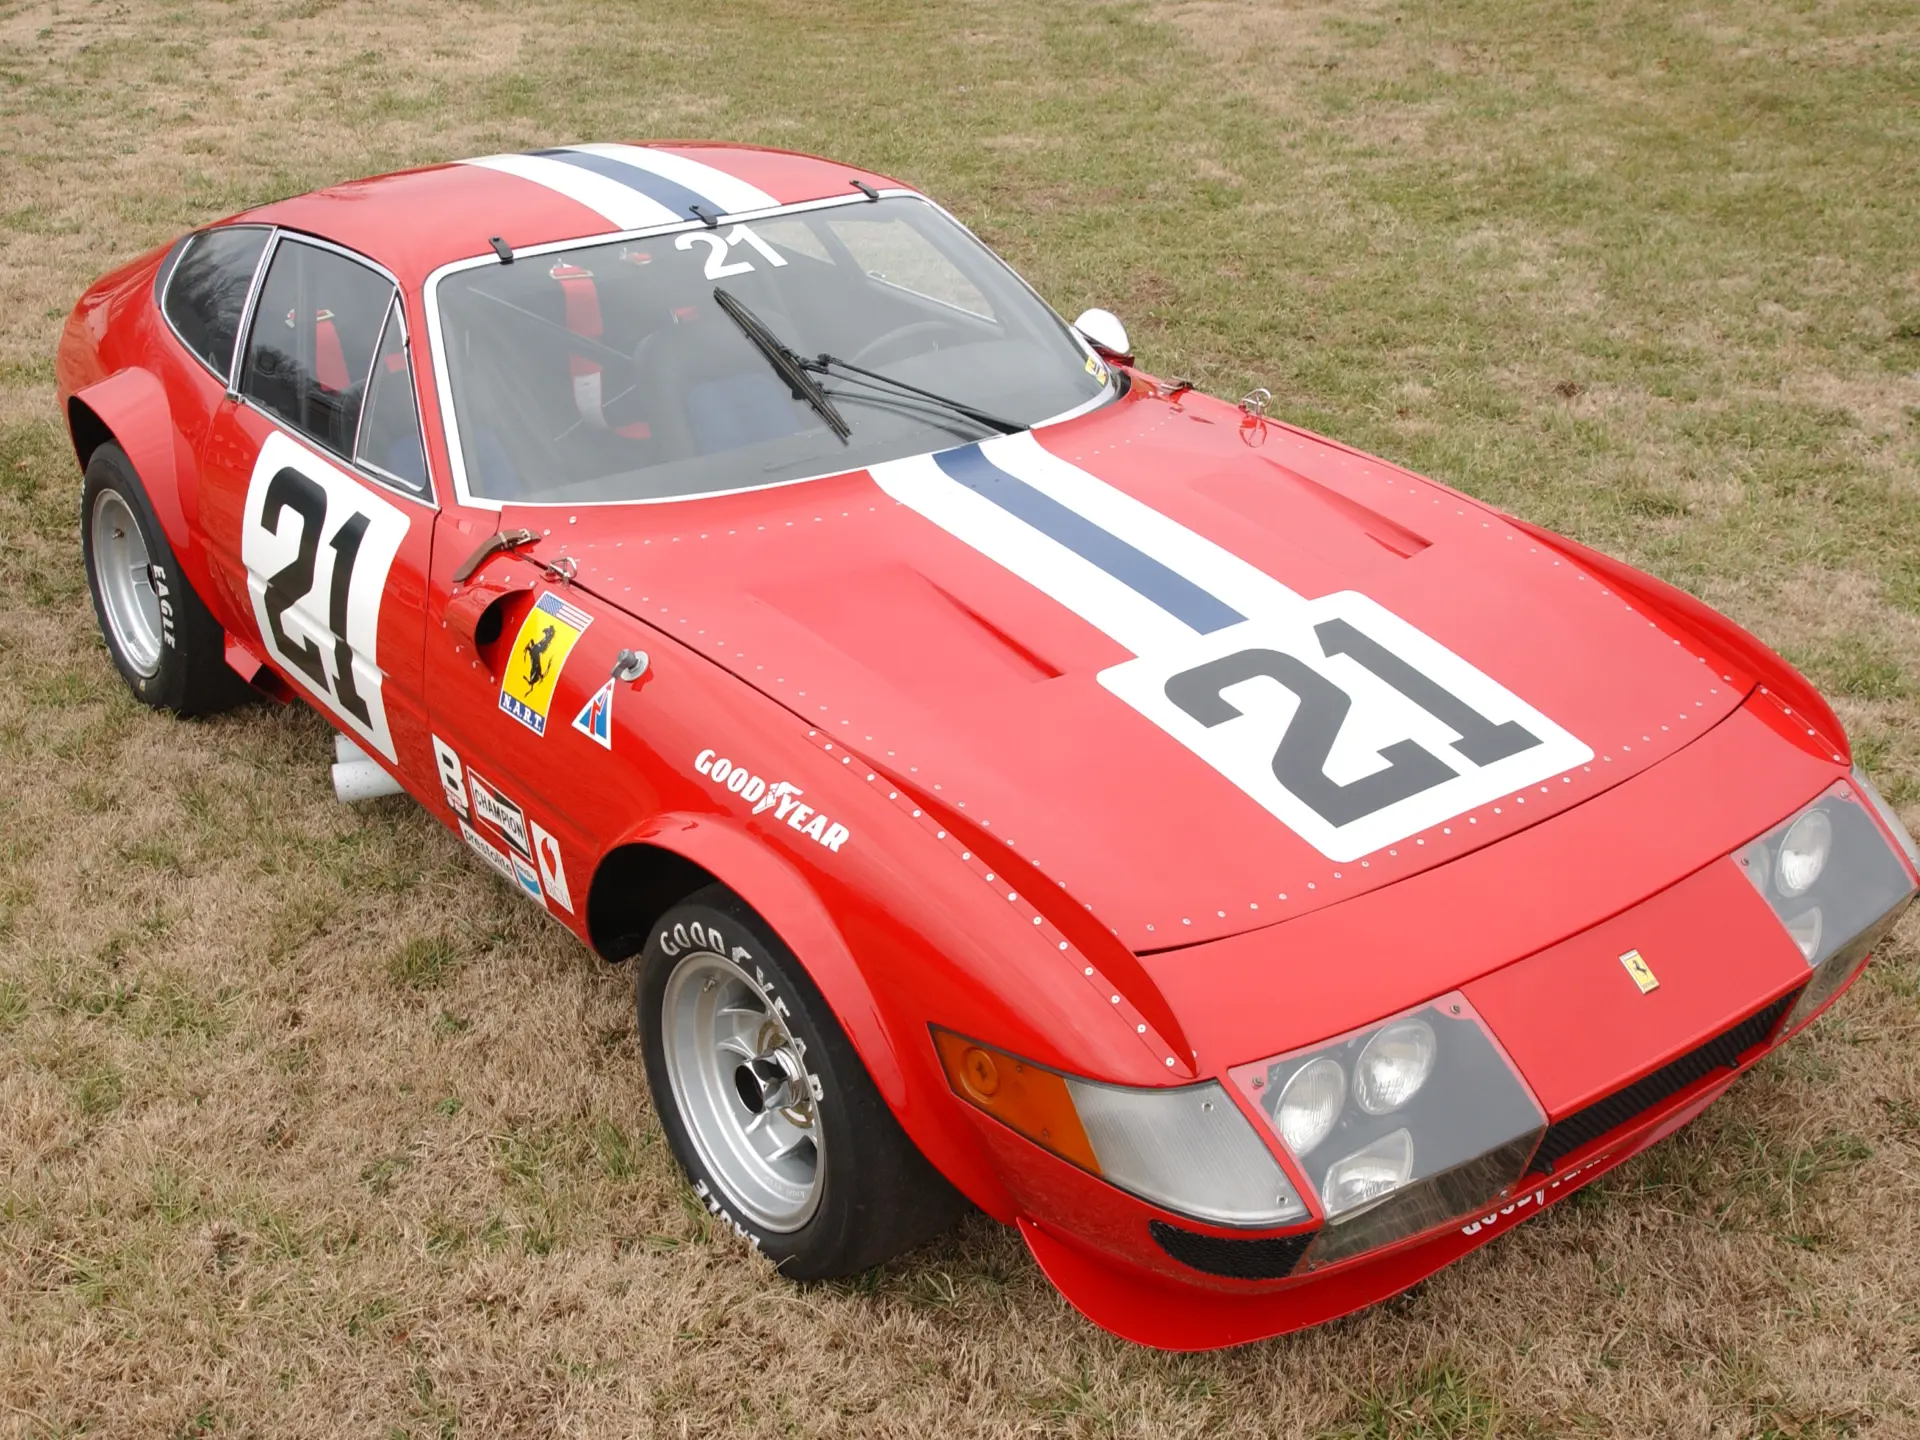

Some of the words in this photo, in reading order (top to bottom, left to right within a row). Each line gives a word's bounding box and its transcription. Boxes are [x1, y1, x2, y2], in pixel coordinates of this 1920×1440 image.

[674, 223, 789, 281] 21
[153, 564, 176, 650] EAGLE
[261, 466, 374, 732] 21
[1164, 617, 1545, 829] 21
[474, 787, 524, 841] CHAMPION
[694, 749, 850, 854] GOODYEAR
